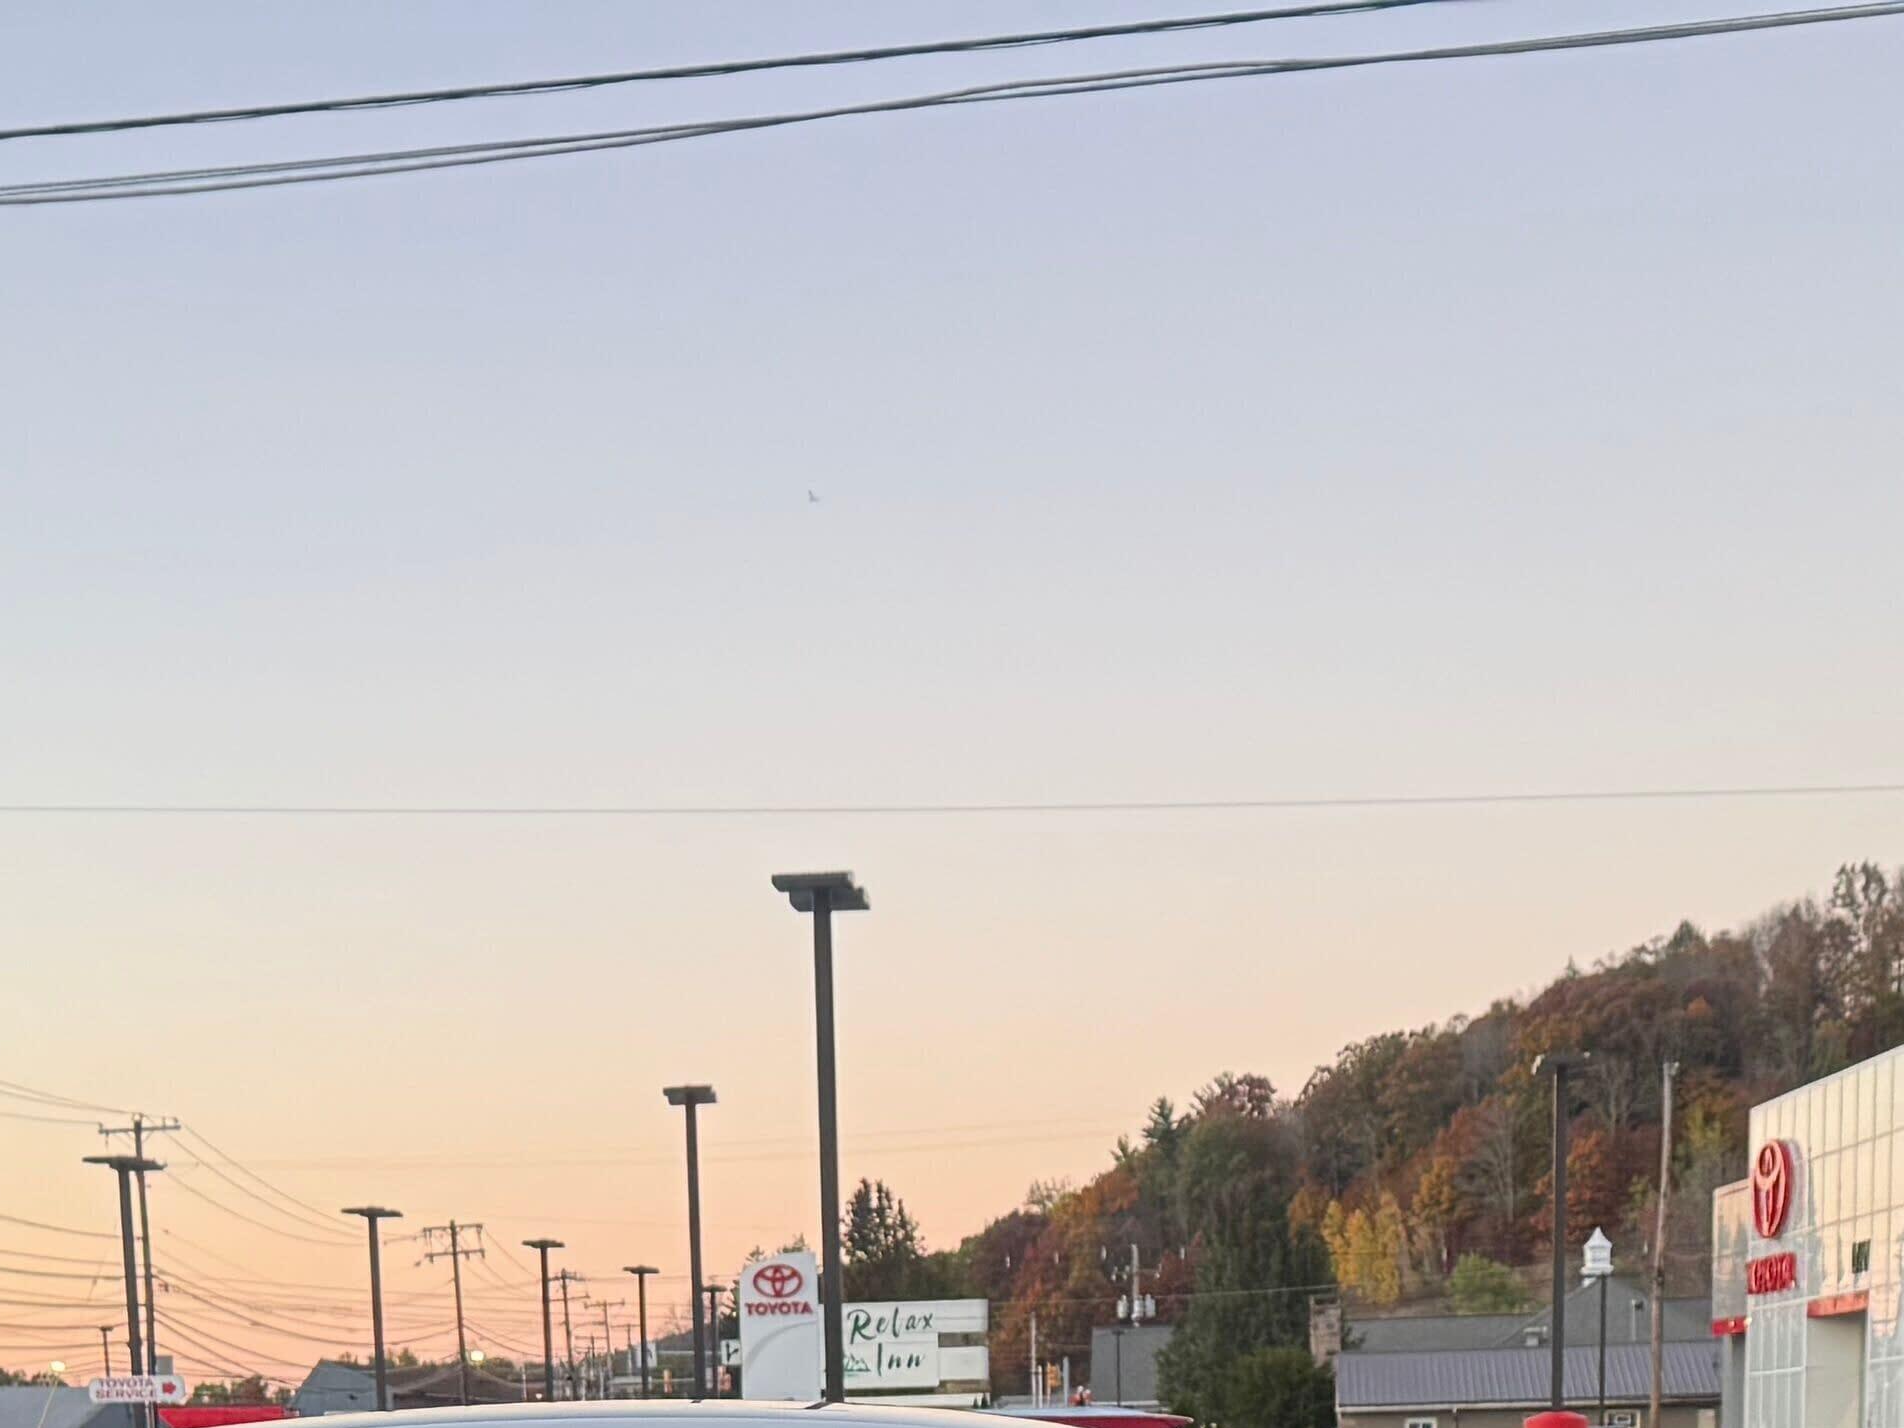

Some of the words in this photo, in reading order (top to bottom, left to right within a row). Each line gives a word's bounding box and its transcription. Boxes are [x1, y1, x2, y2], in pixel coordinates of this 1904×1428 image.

[1746, 1251, 1797, 1295] TOYOTA
[746, 1301, 813, 1317] TOYOTA
[847, 1307, 934, 1344] Relax
[877, 1342, 924, 1376] Inn
[96, 1389, 155, 1398] SERVICE
[99, 1378, 154, 1387] TOYOTA
